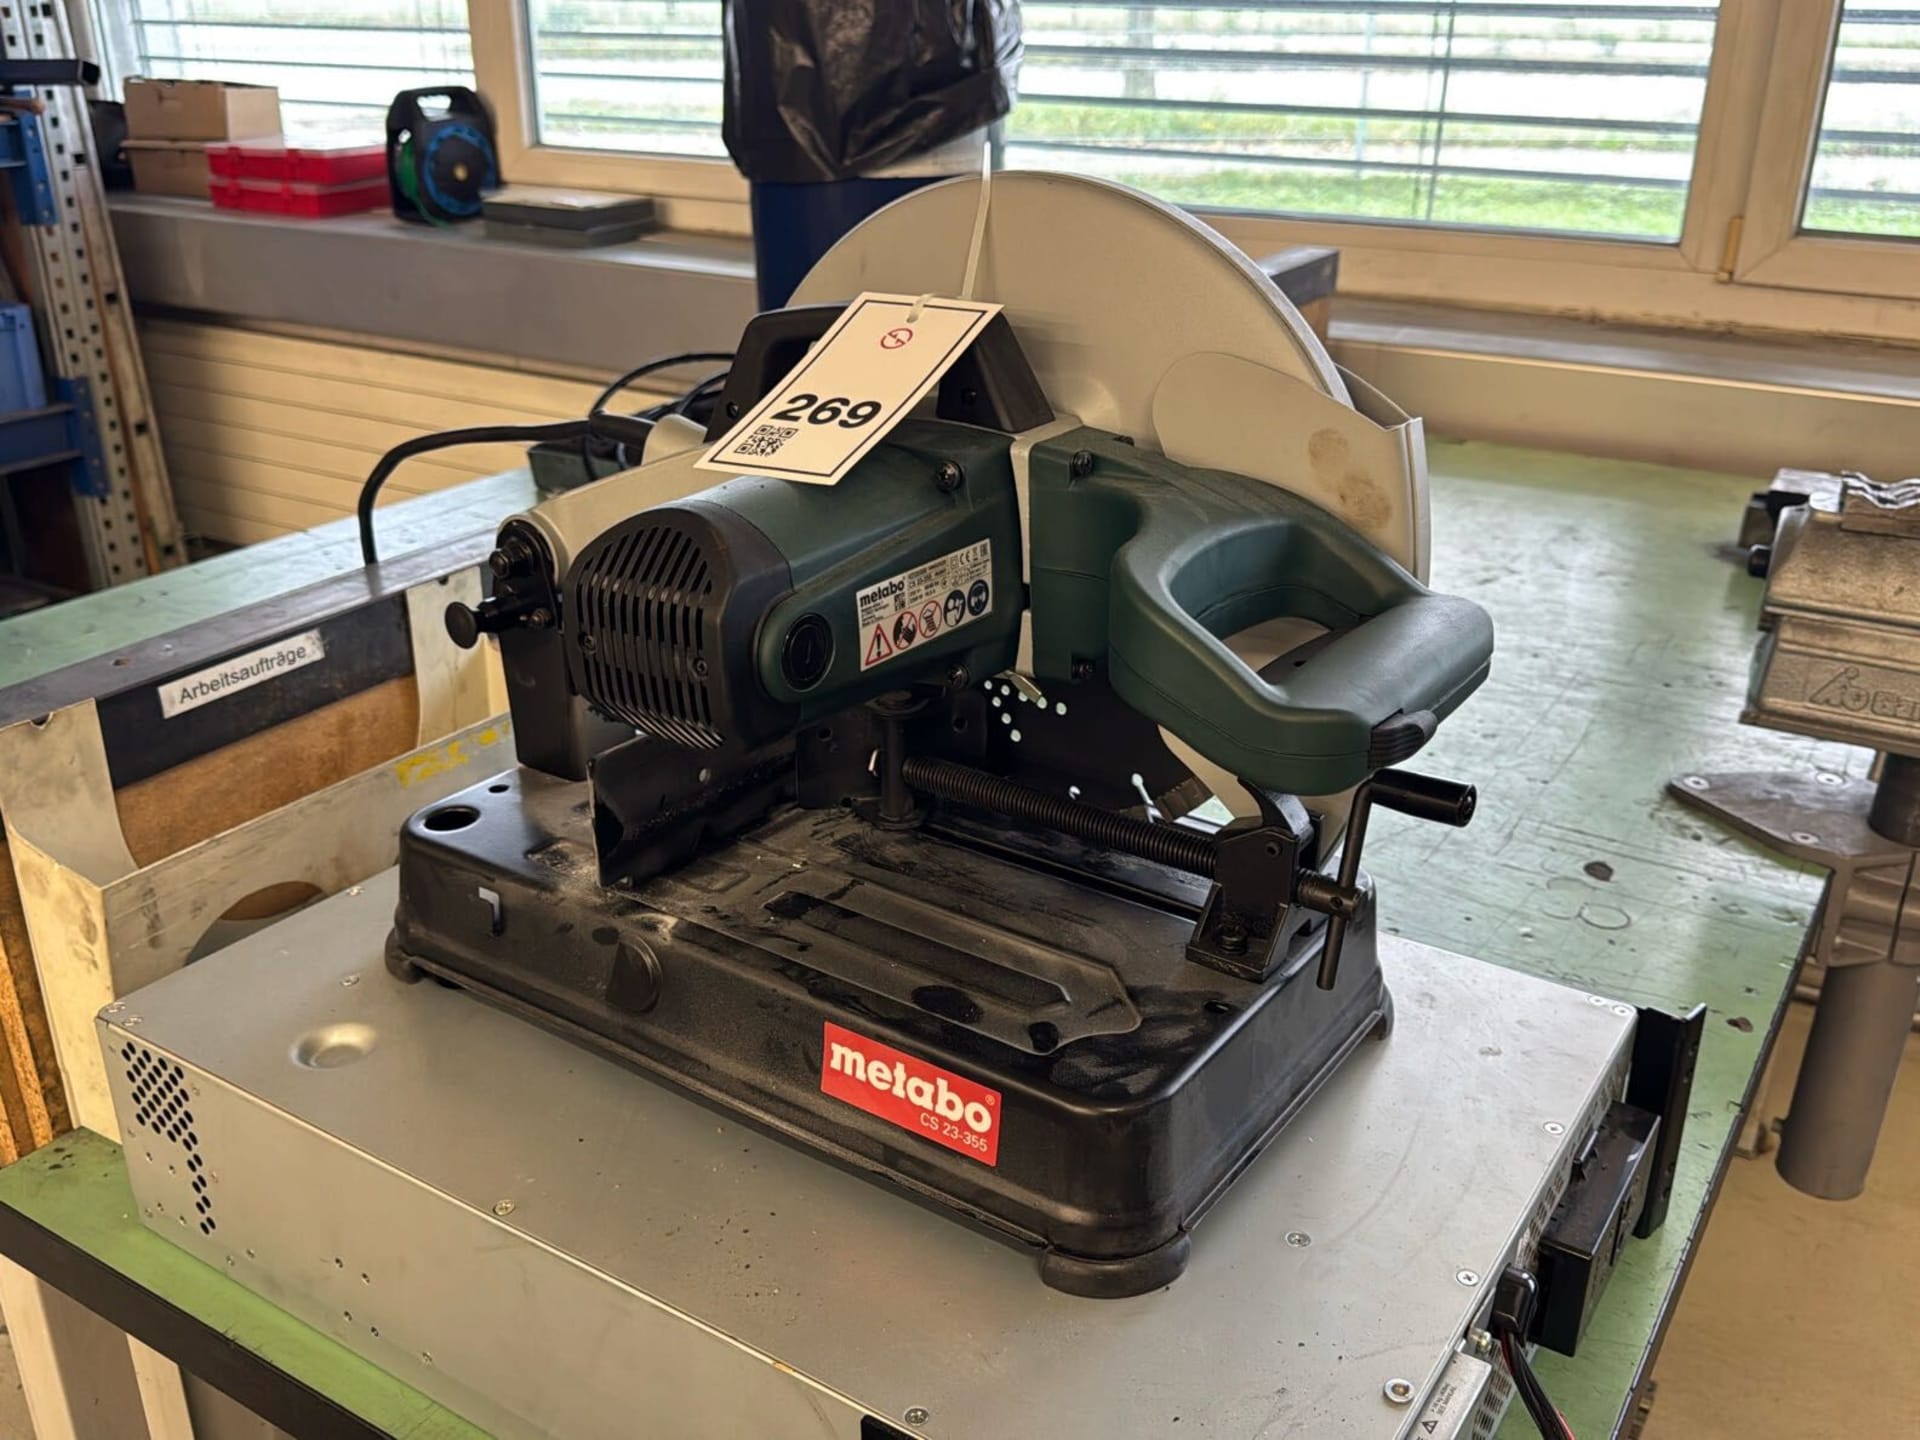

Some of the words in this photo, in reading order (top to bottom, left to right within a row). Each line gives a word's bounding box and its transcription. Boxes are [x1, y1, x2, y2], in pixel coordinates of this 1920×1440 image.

[770, 393, 882, 429] 269
[859, 577, 906, 609] metabo
[179, 646, 306, 704] Arbeitsaufträge
[830, 1042, 992, 1133] metabo
[920, 1112, 939, 1131] CS
[942, 1122, 988, 1152] 23-355
